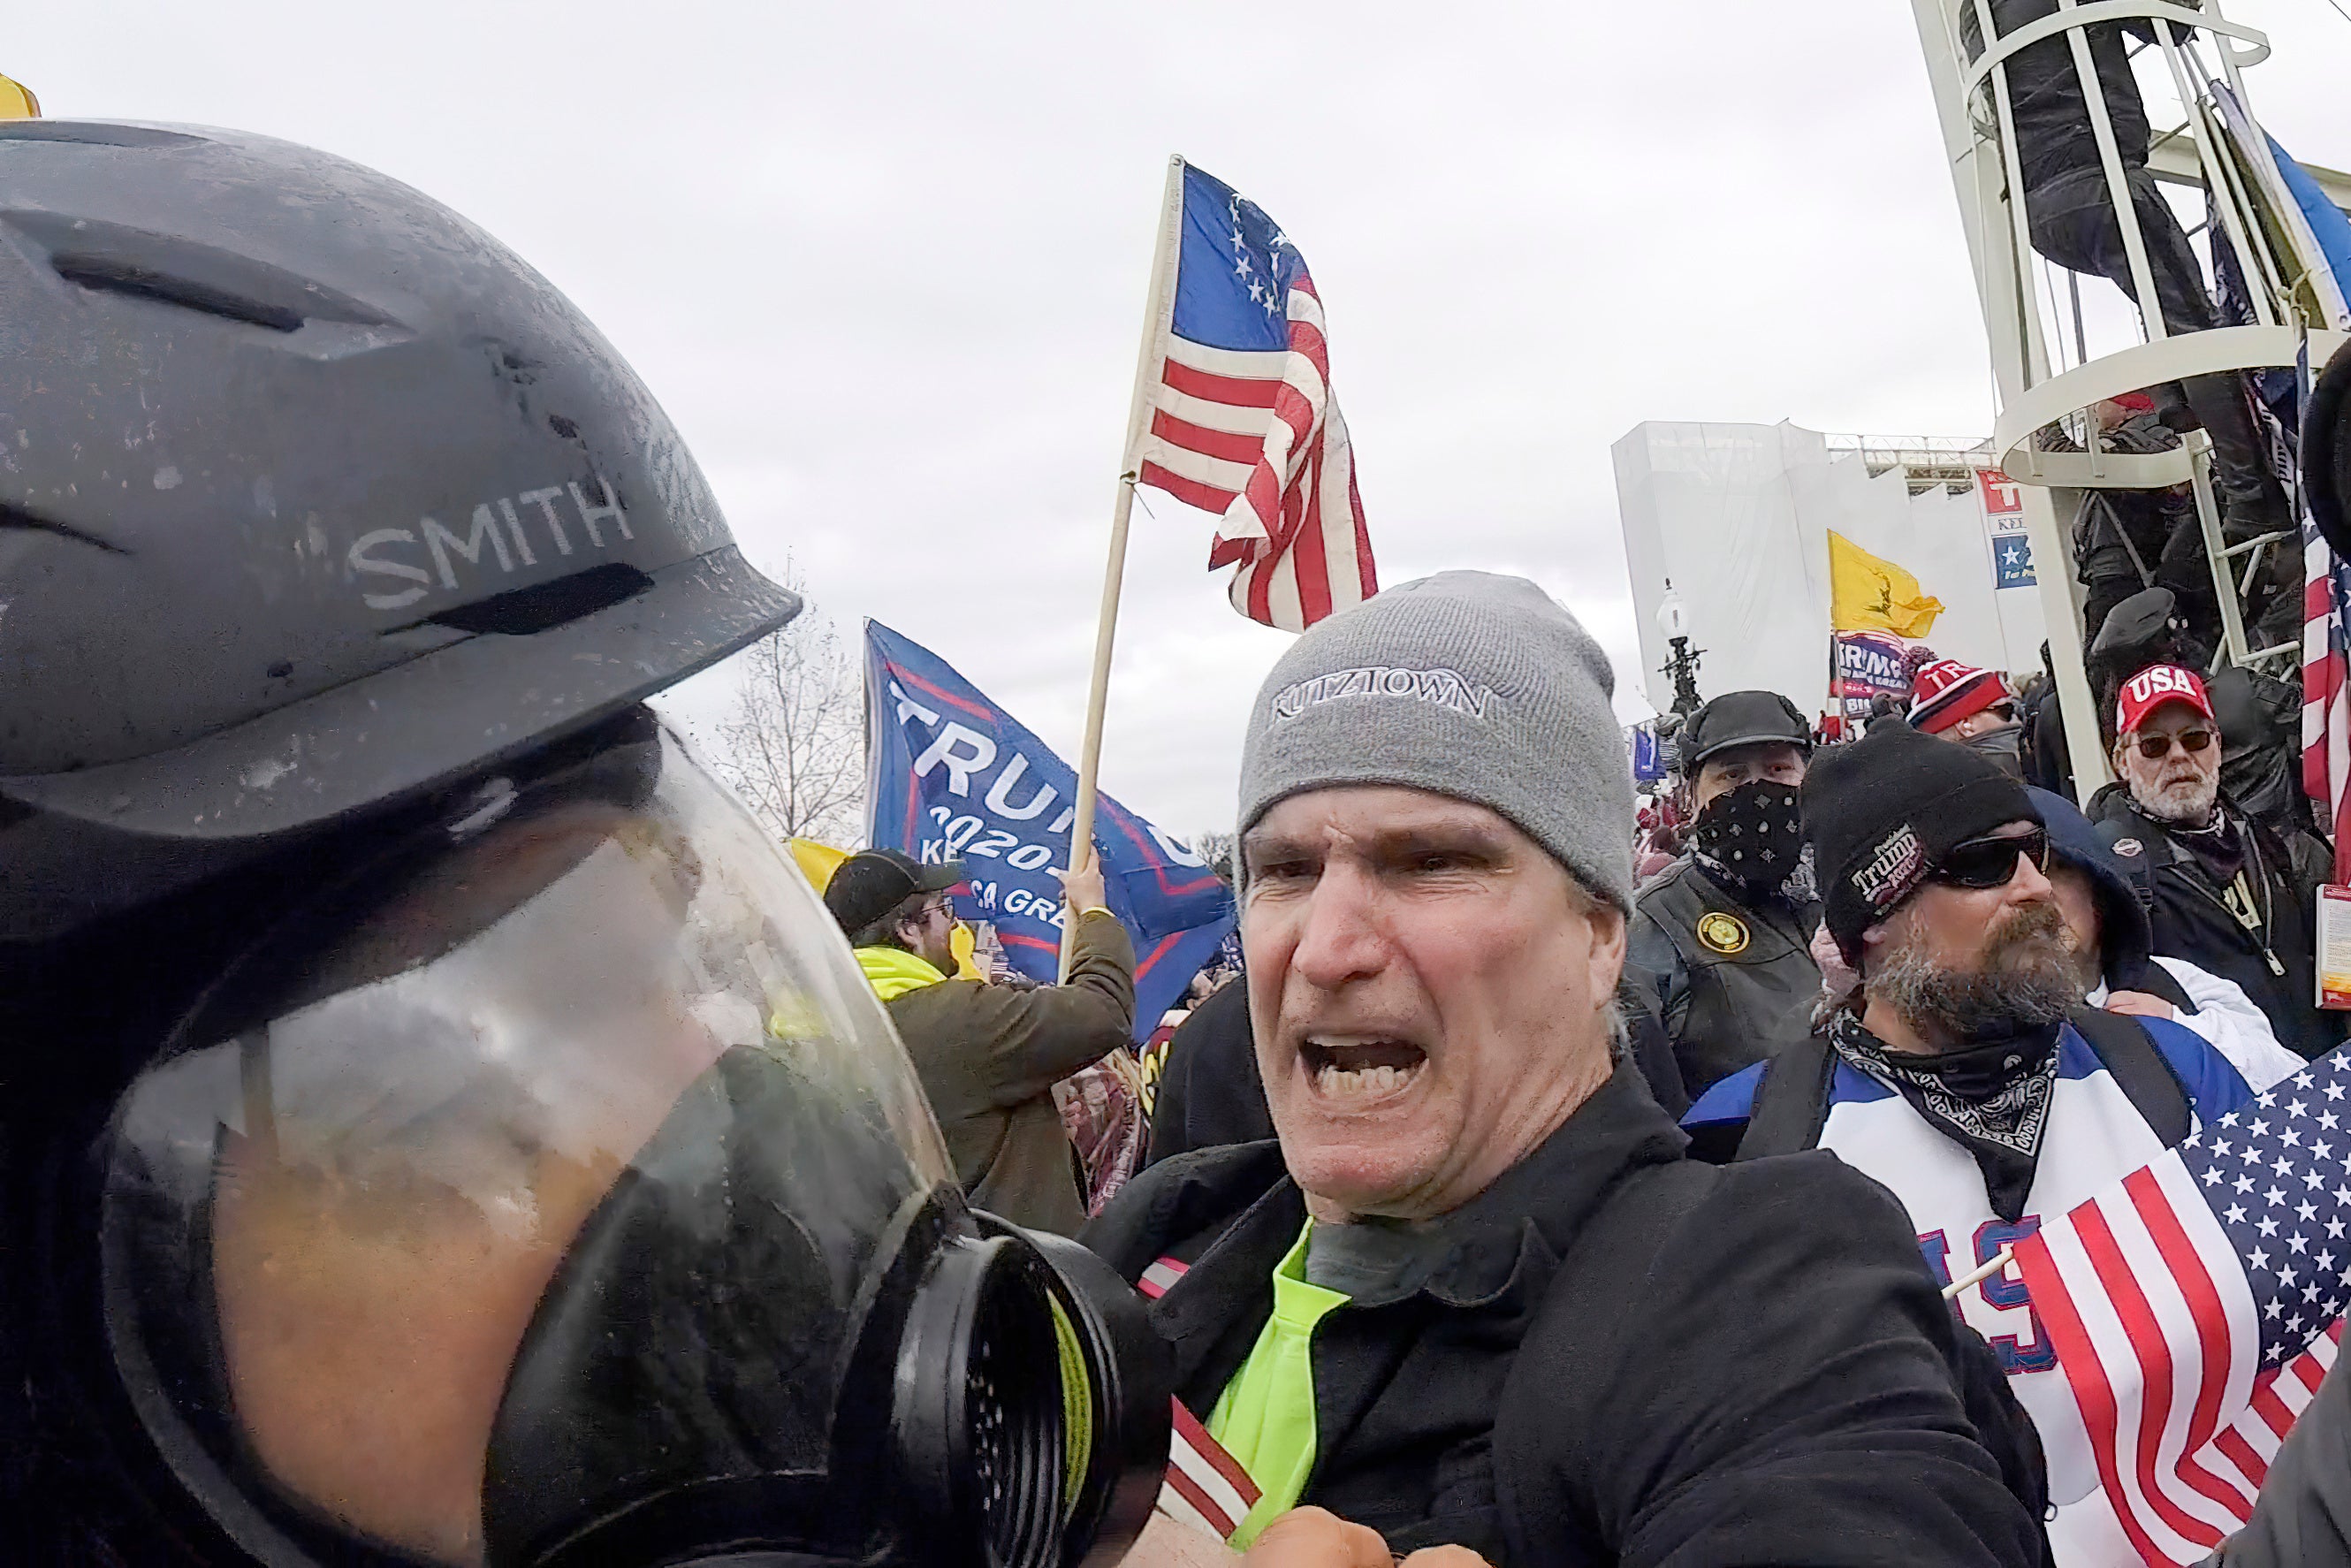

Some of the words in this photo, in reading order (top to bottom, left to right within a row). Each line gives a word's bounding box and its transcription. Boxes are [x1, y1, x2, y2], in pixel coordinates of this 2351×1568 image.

[349, 475, 634, 610] SMITH
[2127, 667, 2197, 703] USA
[1851, 833, 1918, 896] Trump
